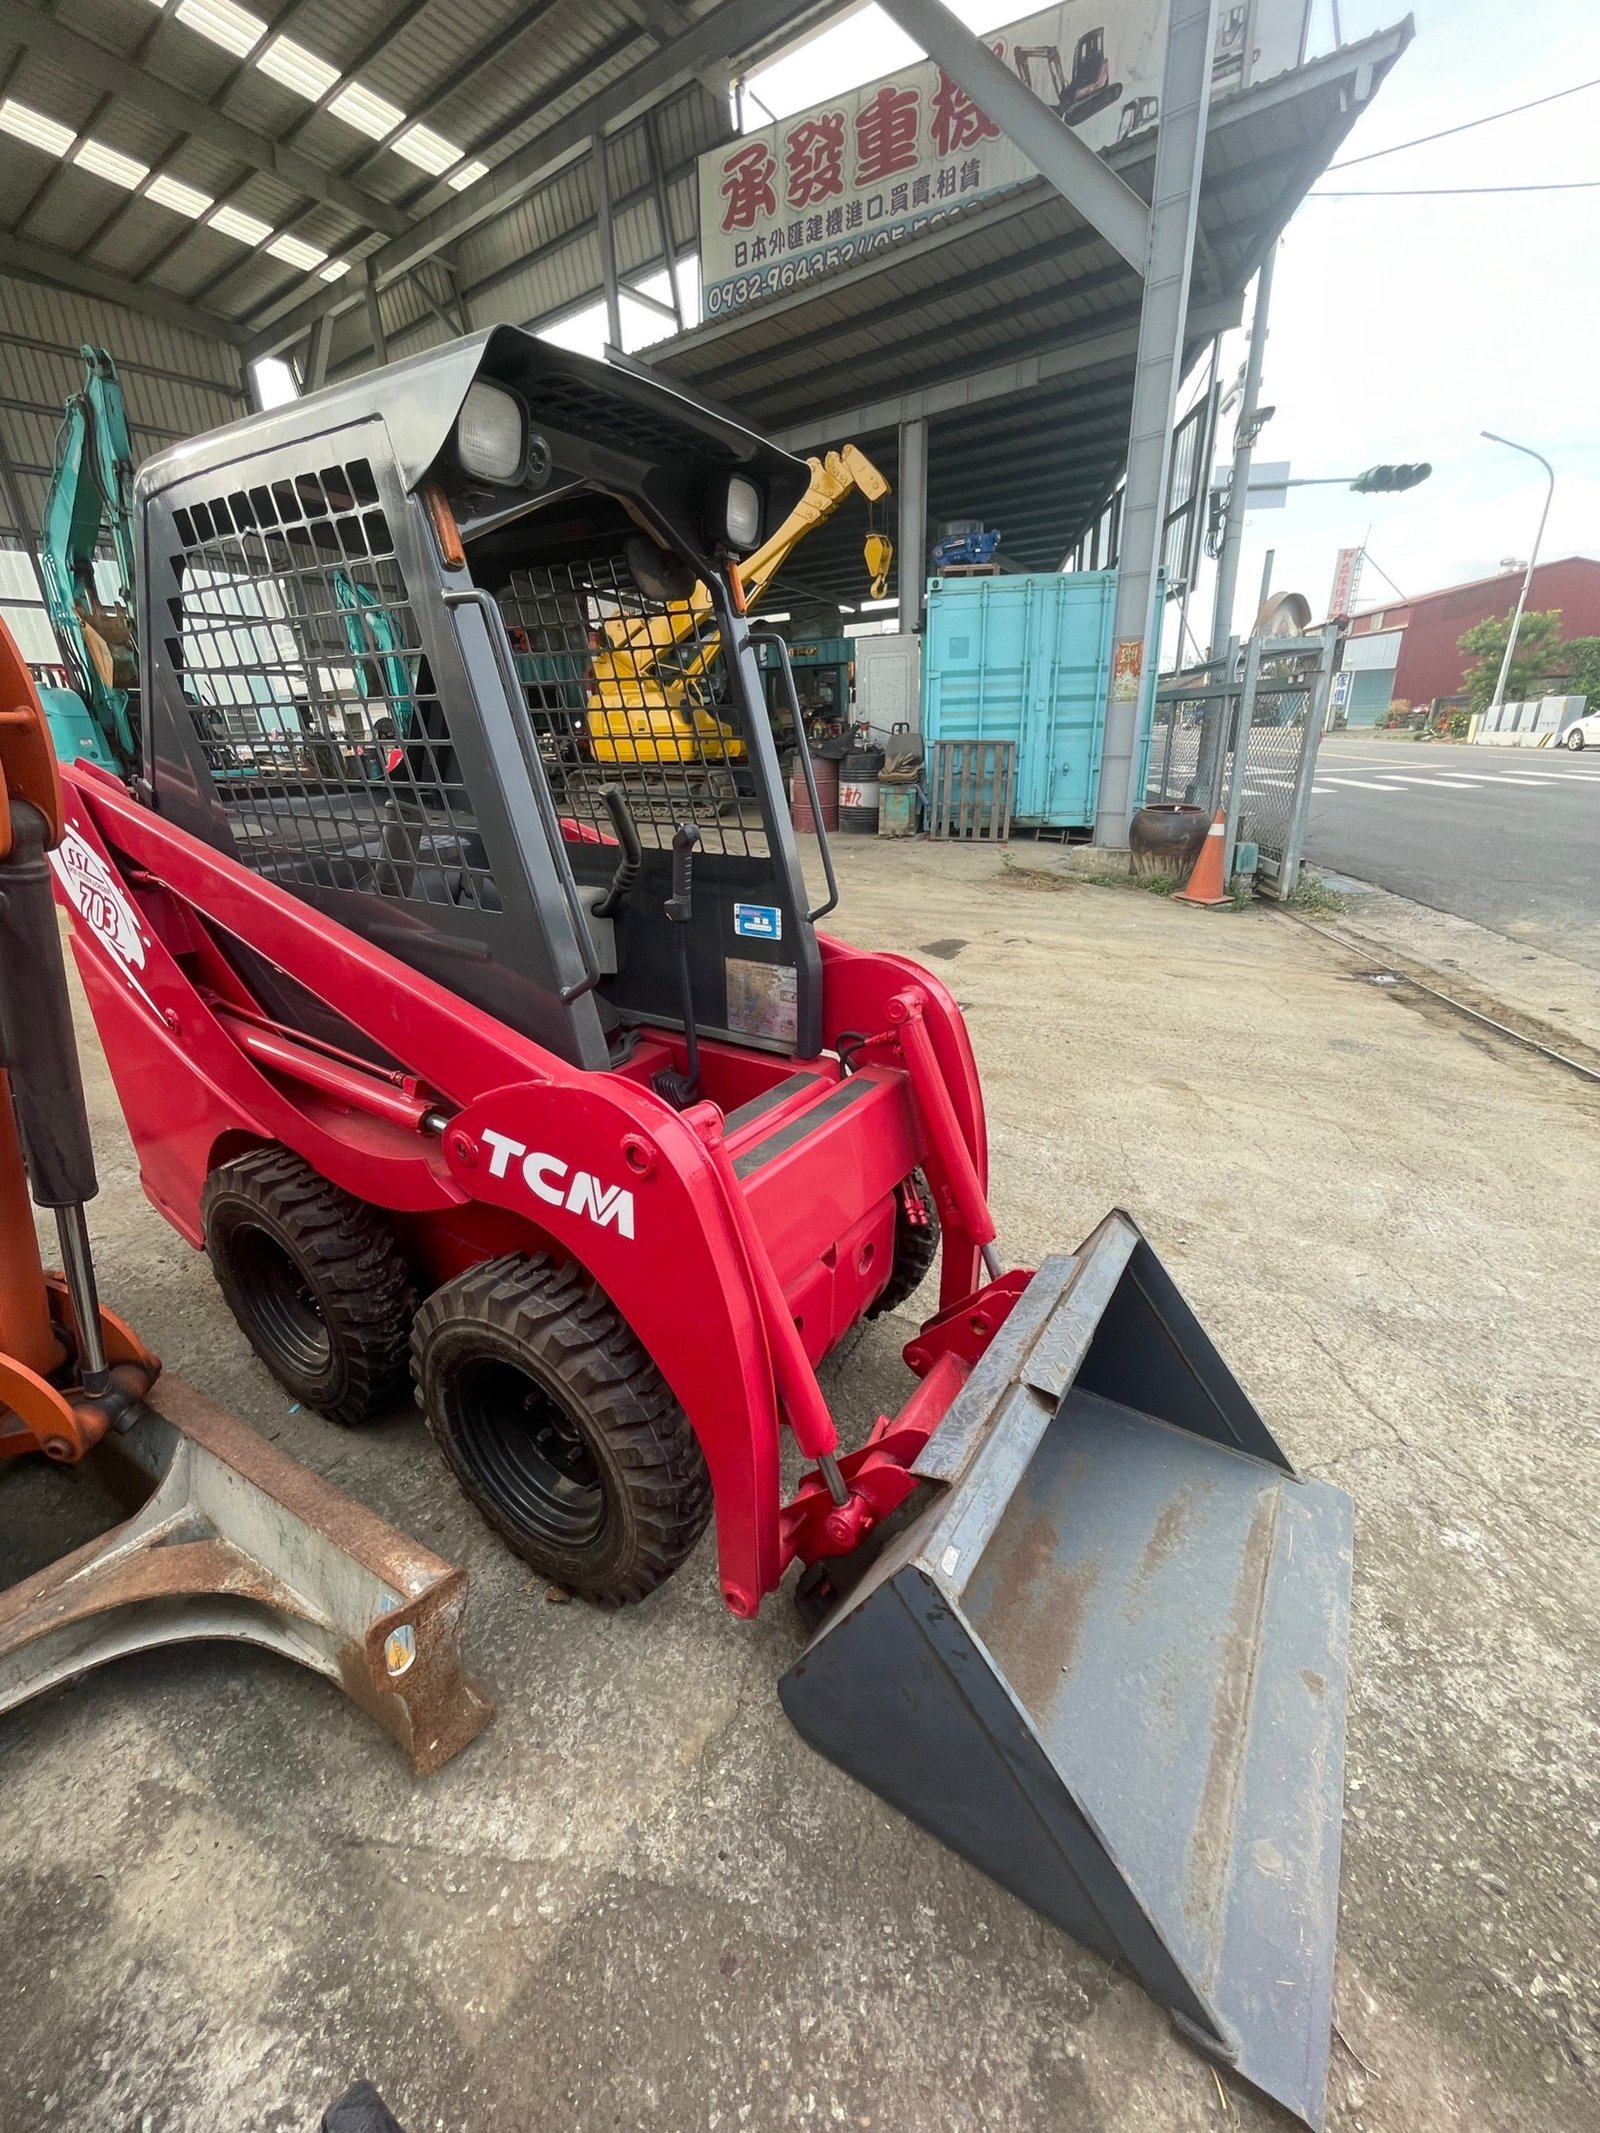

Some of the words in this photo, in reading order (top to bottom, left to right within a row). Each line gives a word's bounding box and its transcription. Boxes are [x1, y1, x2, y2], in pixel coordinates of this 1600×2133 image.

[720, 50, 1003, 231] 承發重機
[68, 848, 104, 884] SSL
[80, 881, 119, 940] 703
[481, 1128, 635, 1241] TCM
